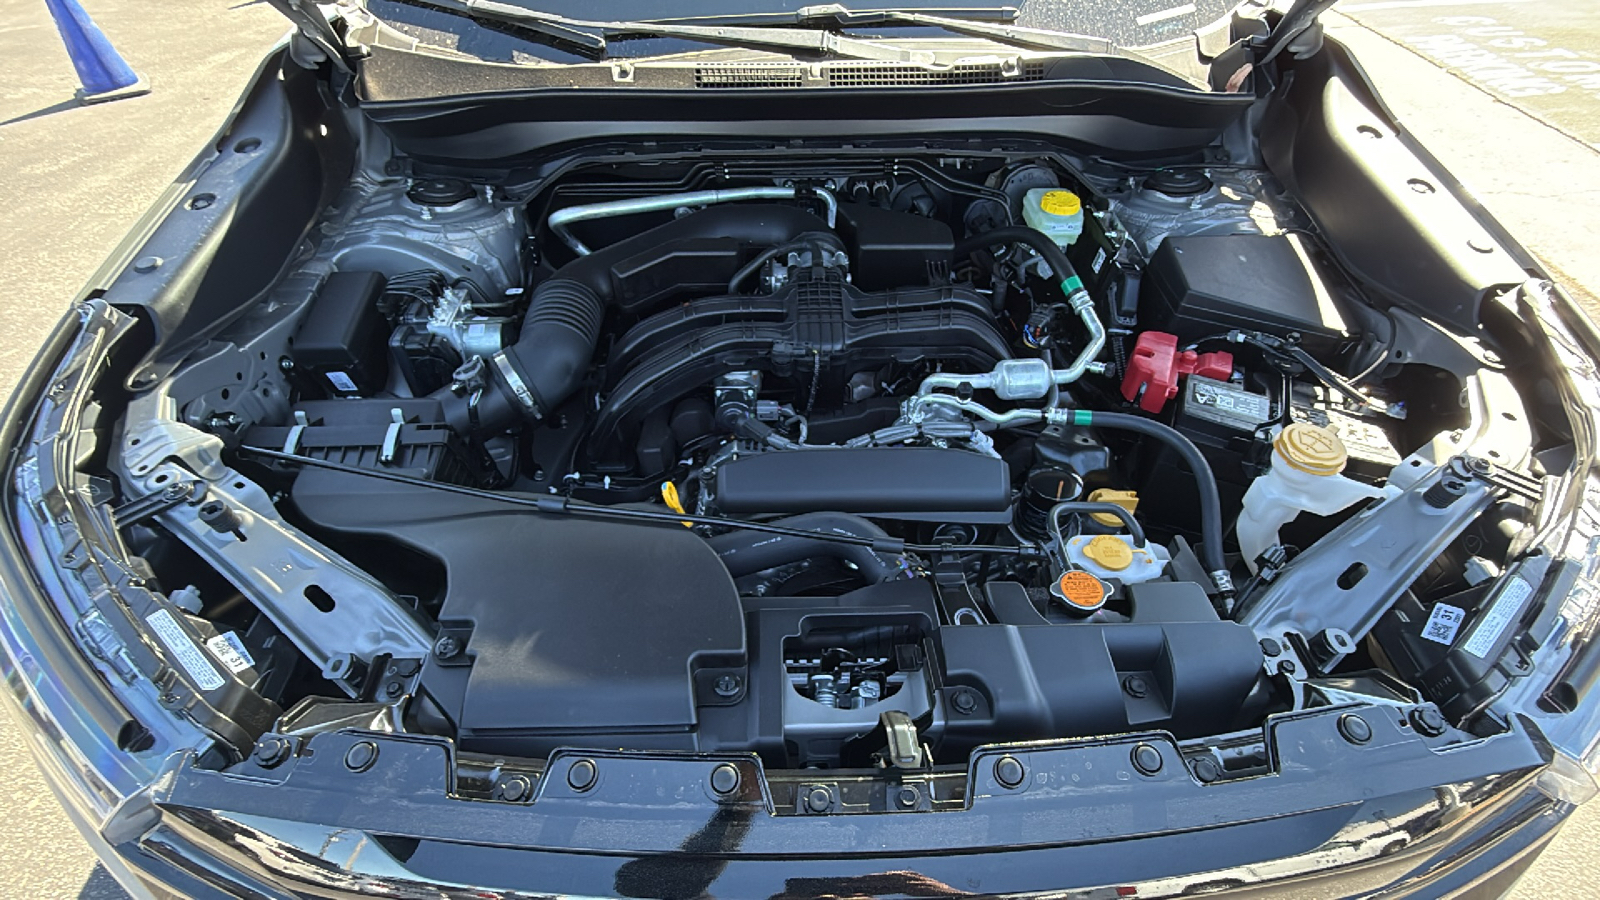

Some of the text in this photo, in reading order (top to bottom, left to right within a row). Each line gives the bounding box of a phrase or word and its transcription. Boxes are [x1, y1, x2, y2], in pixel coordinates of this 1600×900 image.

[1406, 33, 1567, 97] PARKING
[1430, 15, 1600, 100] CUSTOM
[1441, 609, 1454, 621] 31
[230, 656, 243, 667] 31
